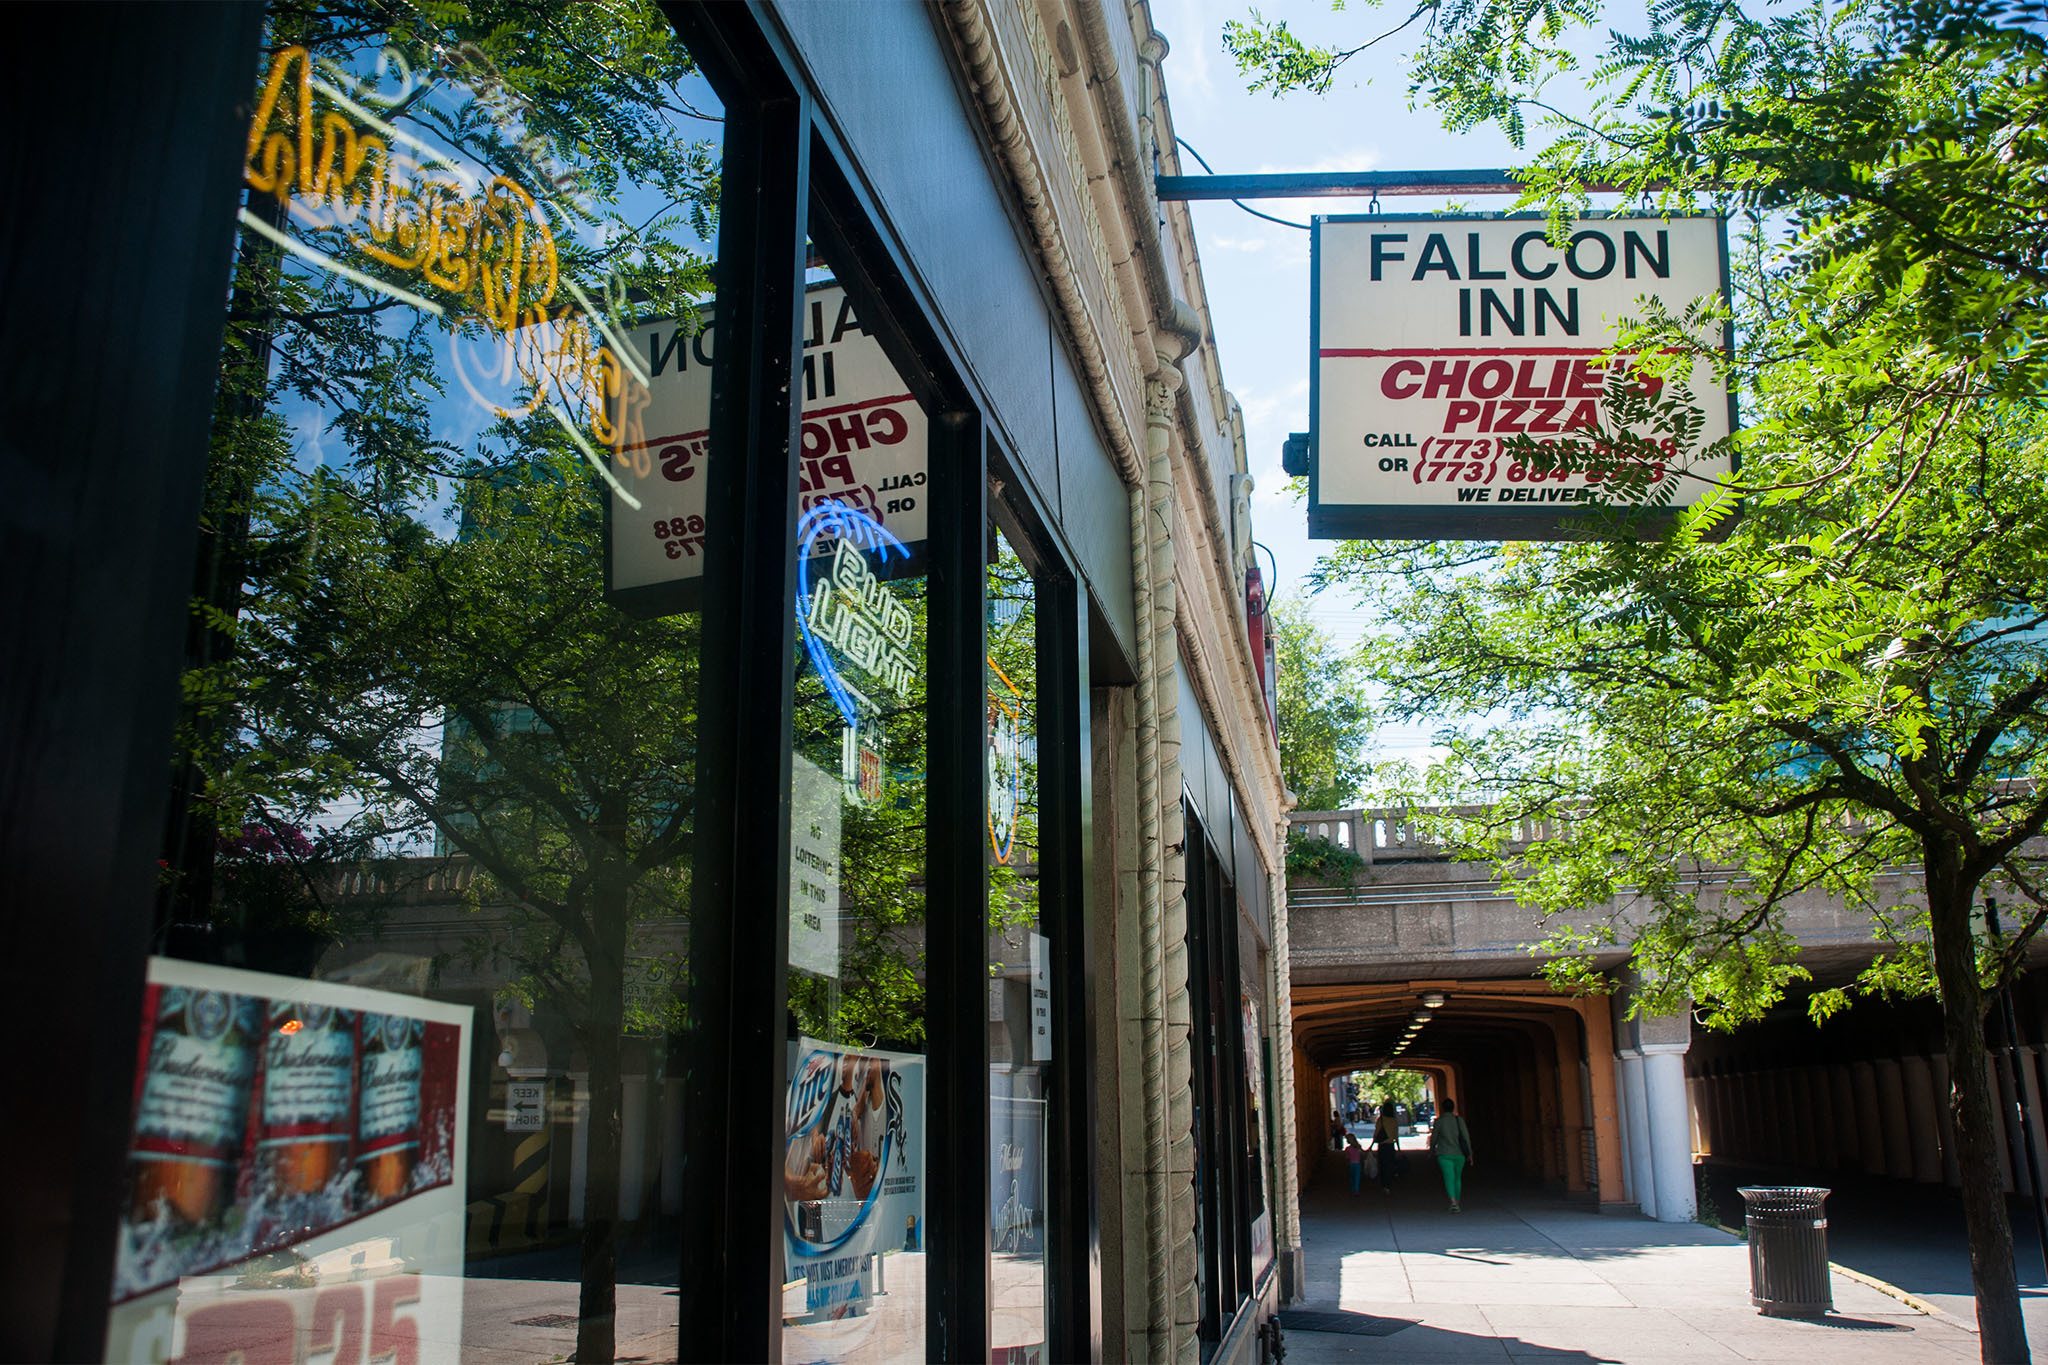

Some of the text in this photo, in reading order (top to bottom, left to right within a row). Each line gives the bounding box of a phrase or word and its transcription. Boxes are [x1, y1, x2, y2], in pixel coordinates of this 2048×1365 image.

[1370, 230, 1671, 281] FALCON
[1458, 287, 1579, 336] INN
[1380, 358, 1665, 400] CHOLIE'S
[1442, 400, 1600, 433] PIZZA
[1363, 433, 1417, 448] CALL
[1419, 435, 1504, 461] (773)
[1378, 457, 1409, 472] OR
[1412, 460, 1498, 485] (773)
[1457, 488, 1488, 502] WE
[832, 537, 913, 650] BUD
[808, 577, 916, 698] LIGHT
[795, 845, 833, 876] LOITERING
[809, 884, 826, 903] THIS
